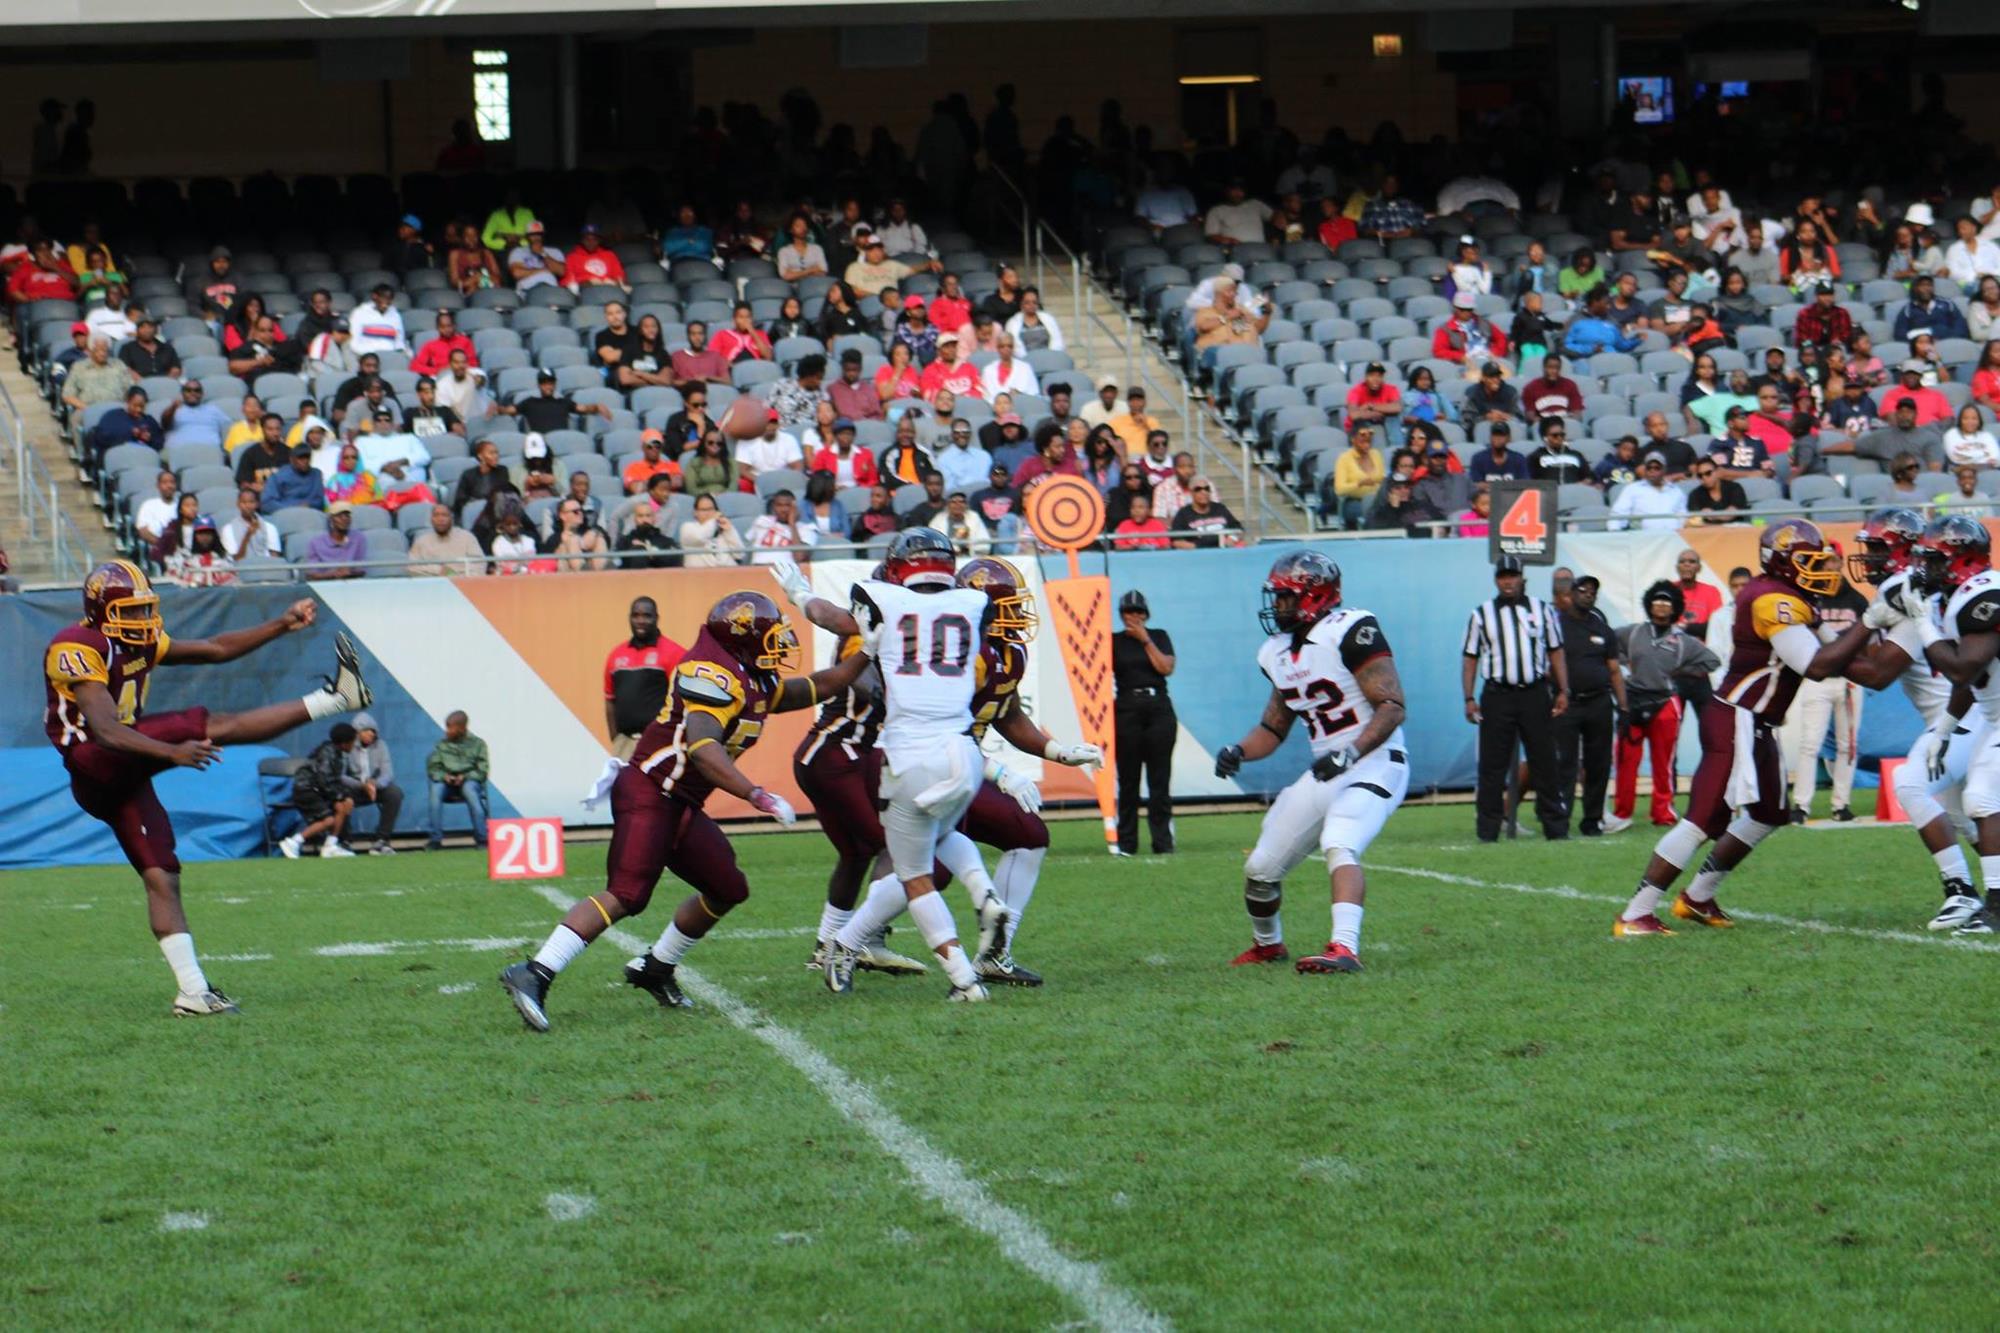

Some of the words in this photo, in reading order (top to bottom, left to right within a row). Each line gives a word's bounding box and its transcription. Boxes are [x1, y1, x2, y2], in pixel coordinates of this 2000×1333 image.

[1499, 488, 1548, 544] 4
[1776, 601, 1793, 625] 6
[58, 651, 94, 678] 41
[895, 613, 971, 676] 10
[495, 823, 558, 875] 20
